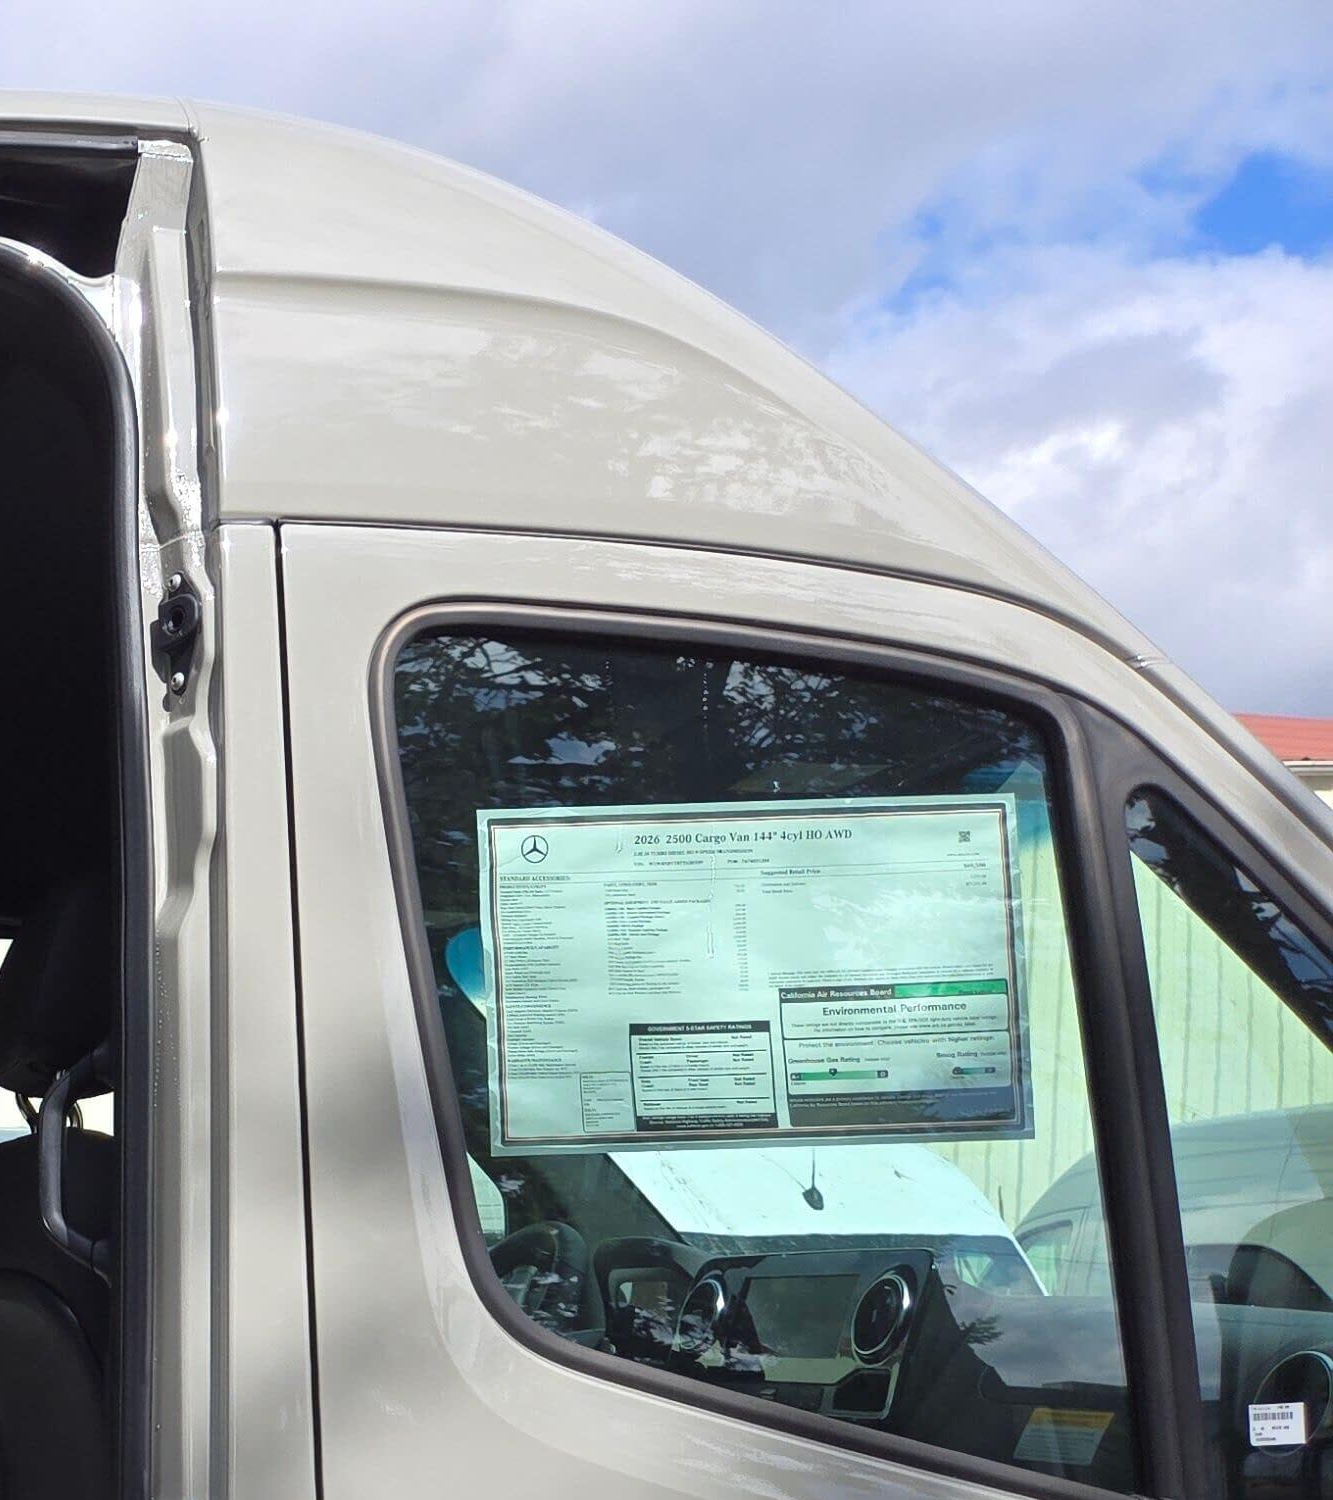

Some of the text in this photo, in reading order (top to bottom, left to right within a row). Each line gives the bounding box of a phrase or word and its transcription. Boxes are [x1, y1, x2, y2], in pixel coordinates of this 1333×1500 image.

[634, 834, 661, 845] 2026
[666, 834, 692, 844] 2500
[695, 833, 727, 846] Cargo
[729, 832, 750, 842] Van
[780, 830, 803, 842] 4cyl
[806, 830, 823, 840] HO
[825, 829, 853, 840] AWD
[781, 988, 892, 1000] California Air Resources Board
[823, 1002, 967, 1016] Environmental Performance
